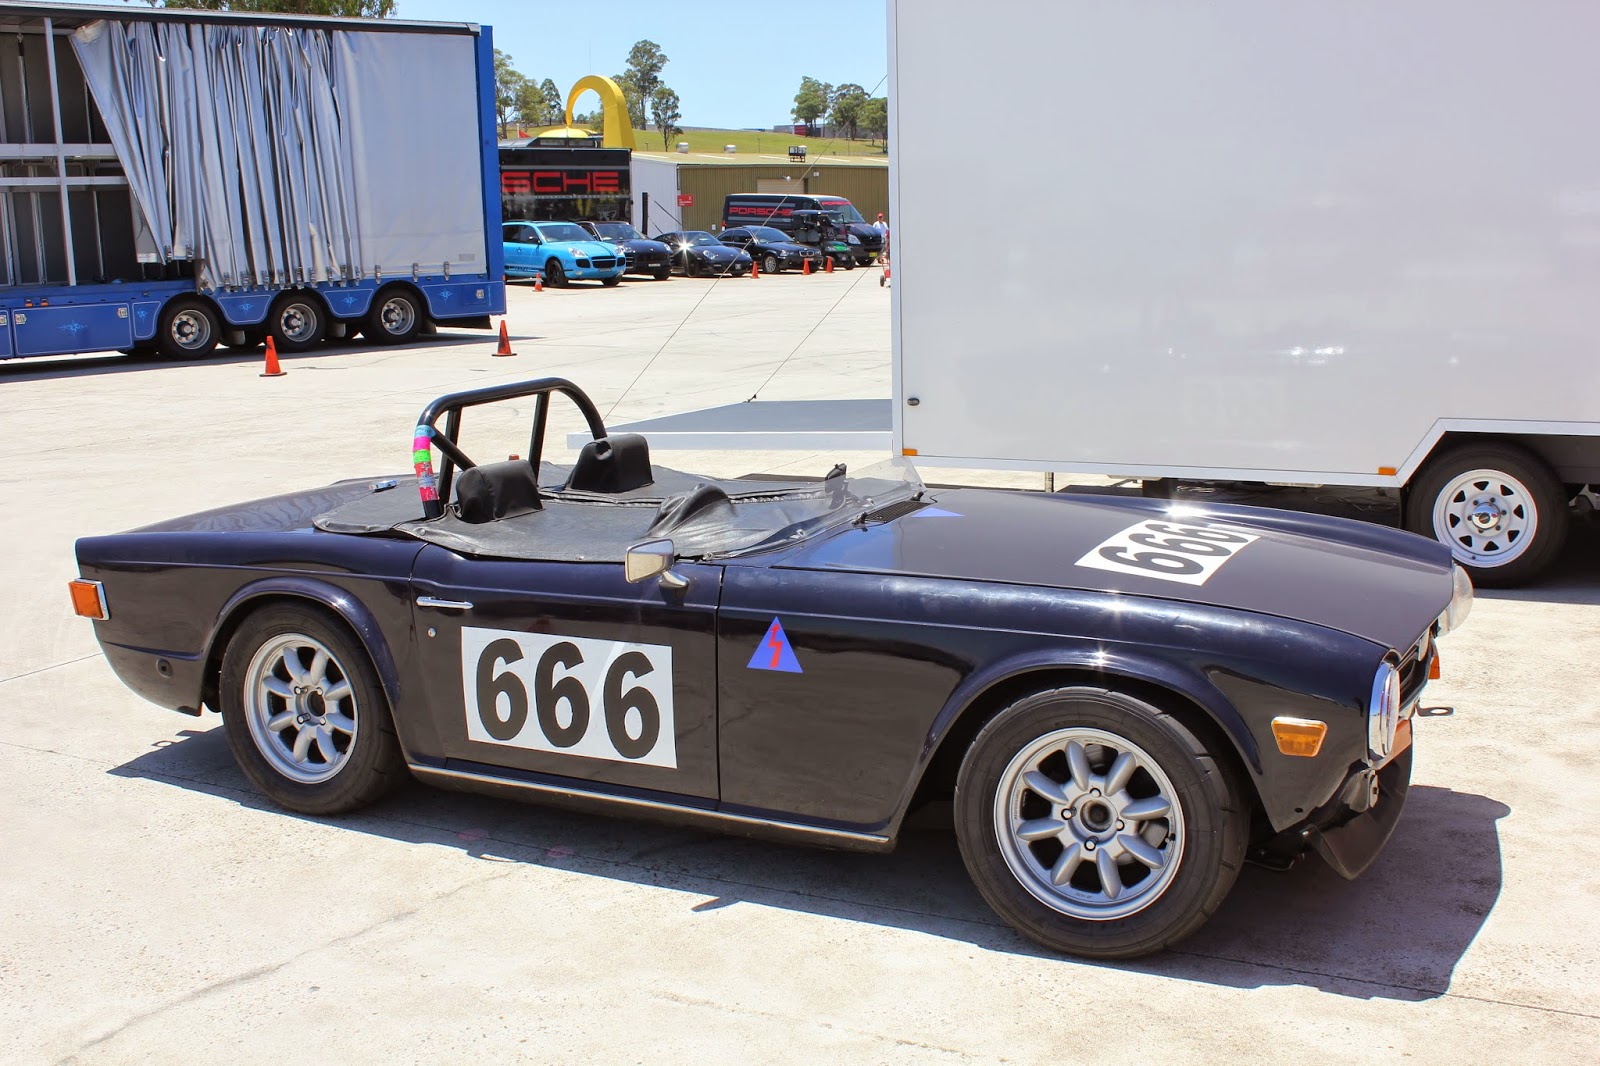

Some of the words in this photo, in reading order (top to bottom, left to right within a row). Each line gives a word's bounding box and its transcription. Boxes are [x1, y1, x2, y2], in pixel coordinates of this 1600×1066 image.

[729, 207, 793, 216] PORSCHE
[1099, 523, 1249, 575] 666
[476, 638, 660, 759] 666
